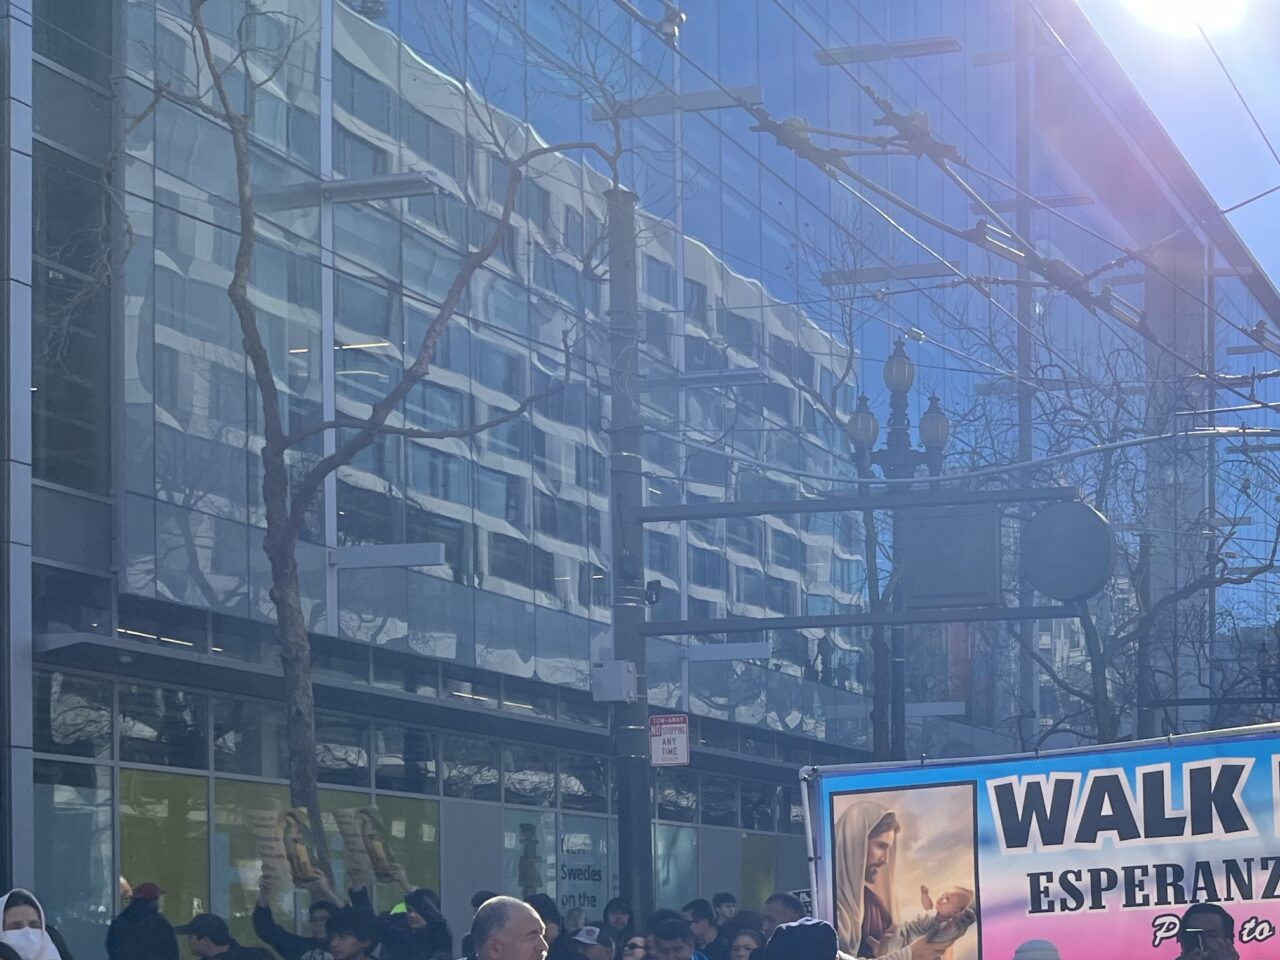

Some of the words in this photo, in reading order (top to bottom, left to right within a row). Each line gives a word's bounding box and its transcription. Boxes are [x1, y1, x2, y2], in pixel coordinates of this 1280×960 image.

[651, 725, 661, 736] NO
[662, 726, 687, 735] STOPPING
[662, 738, 676, 746] ANY
[662, 747, 678, 756] TIME
[988, 760, 1254, 852] WALK
[561, 865, 602, 881] Swedes
[561, 894, 576, 907] on
[579, 891, 597, 907] the
[1240, 914, 1274, 942] to
